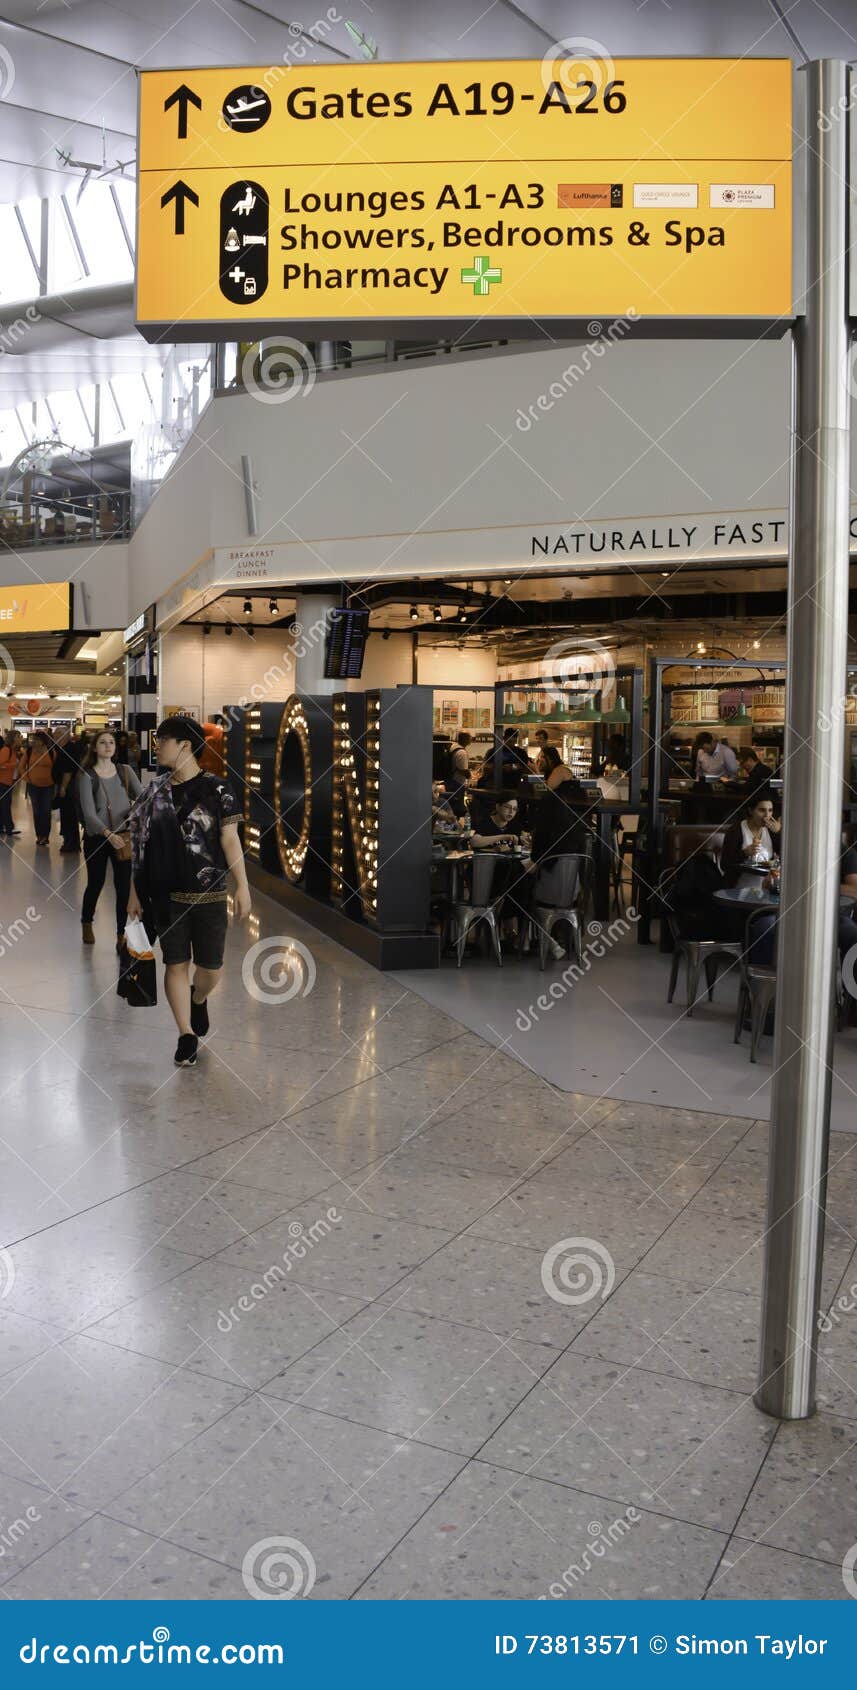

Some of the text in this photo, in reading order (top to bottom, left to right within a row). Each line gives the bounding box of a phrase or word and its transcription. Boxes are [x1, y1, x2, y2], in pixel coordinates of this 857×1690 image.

[286, 80, 627, 120] Gates A19-A26
[284, 183, 545, 218] Lounges A1-A3
[280, 220, 725, 253] Showers, Bedrooms & Spa
[283, 263, 449, 295] Pharmacy
[229, 549, 275, 560] BREAKFAST
[531, 521, 785, 556] NATURALLY FAST
[236, 569, 268, 577] DINNER
[238, 560, 266, 569] LUNCH
